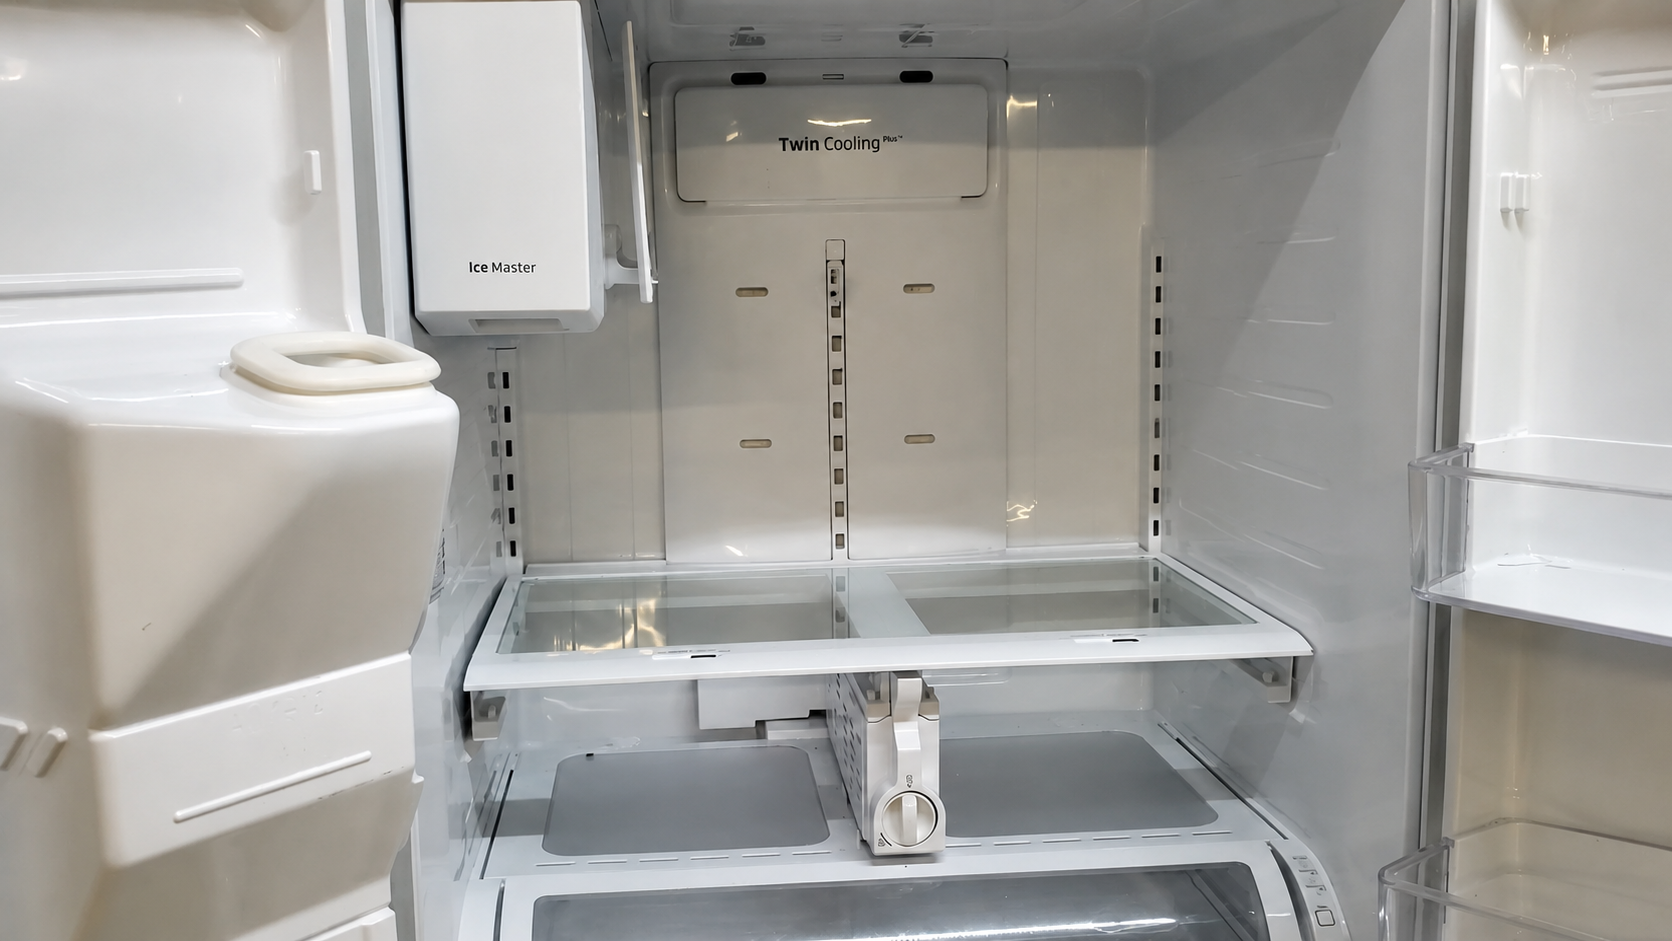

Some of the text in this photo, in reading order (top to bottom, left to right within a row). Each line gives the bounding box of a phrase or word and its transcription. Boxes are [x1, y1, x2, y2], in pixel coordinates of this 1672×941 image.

[778, 137, 820, 152] Twin
[824, 136, 880, 153] Cooling
[468, 261, 537, 274] Ice Master
